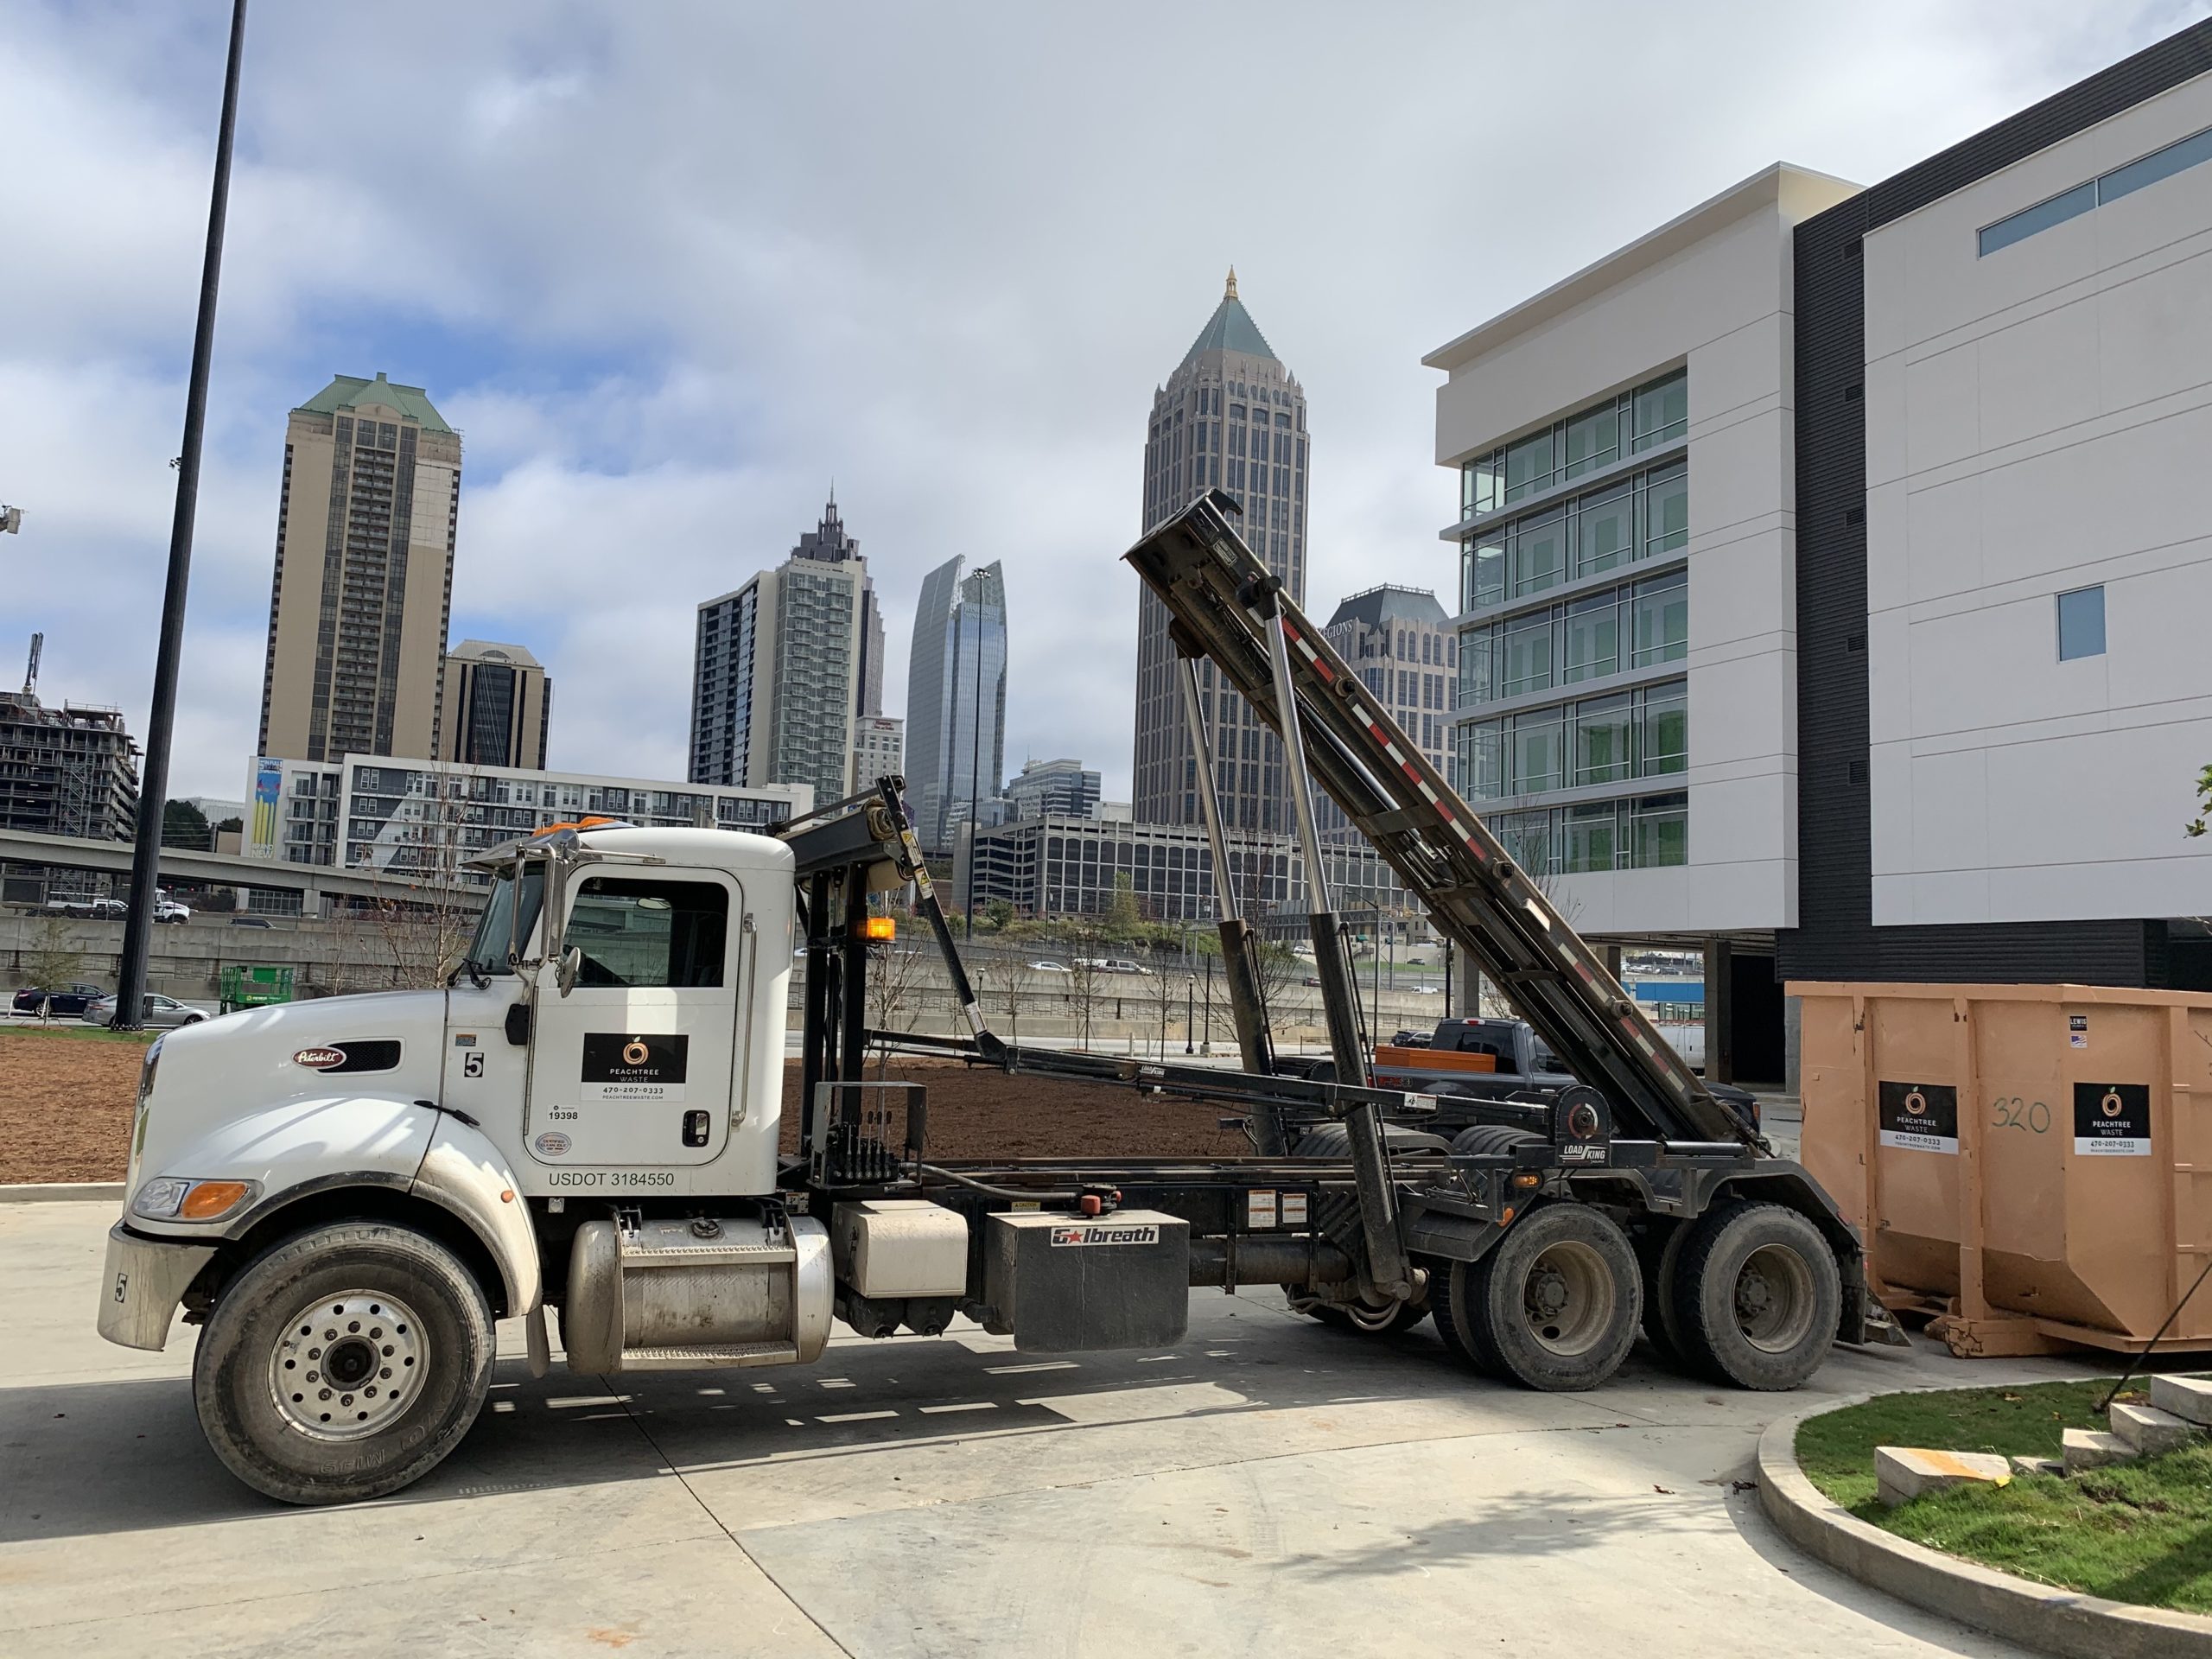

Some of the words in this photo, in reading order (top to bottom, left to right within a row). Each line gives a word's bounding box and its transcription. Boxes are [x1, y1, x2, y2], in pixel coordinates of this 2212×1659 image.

[1318, 619, 1353, 639] EGIONS
[251, 849, 274, 858] NEW
[297, 1051, 340, 1063] Peterbilt
[465, 1052, 483, 1077] 5
[602, 1086, 664, 1095] 470-207-0333
[549, 1111, 578, 1120] 19398
[1896, 1116, 1936, 1127] PEACHTREE
[1992, 1097, 2051, 1134] 320
[1904, 1125, 1929, 1134] WASTE
[2092, 1120, 2132, 1128] PEACHTREE
[1895, 1134, 1942, 1146] 470-207-0333
[1563, 1145, 1584, 1154] LOAD
[1586, 1150, 1606, 1160] KING
[549, 1173, 607, 1186] USDOT
[611, 1173, 675, 1186] 3184550
[115, 1273, 127, 1302] 5
